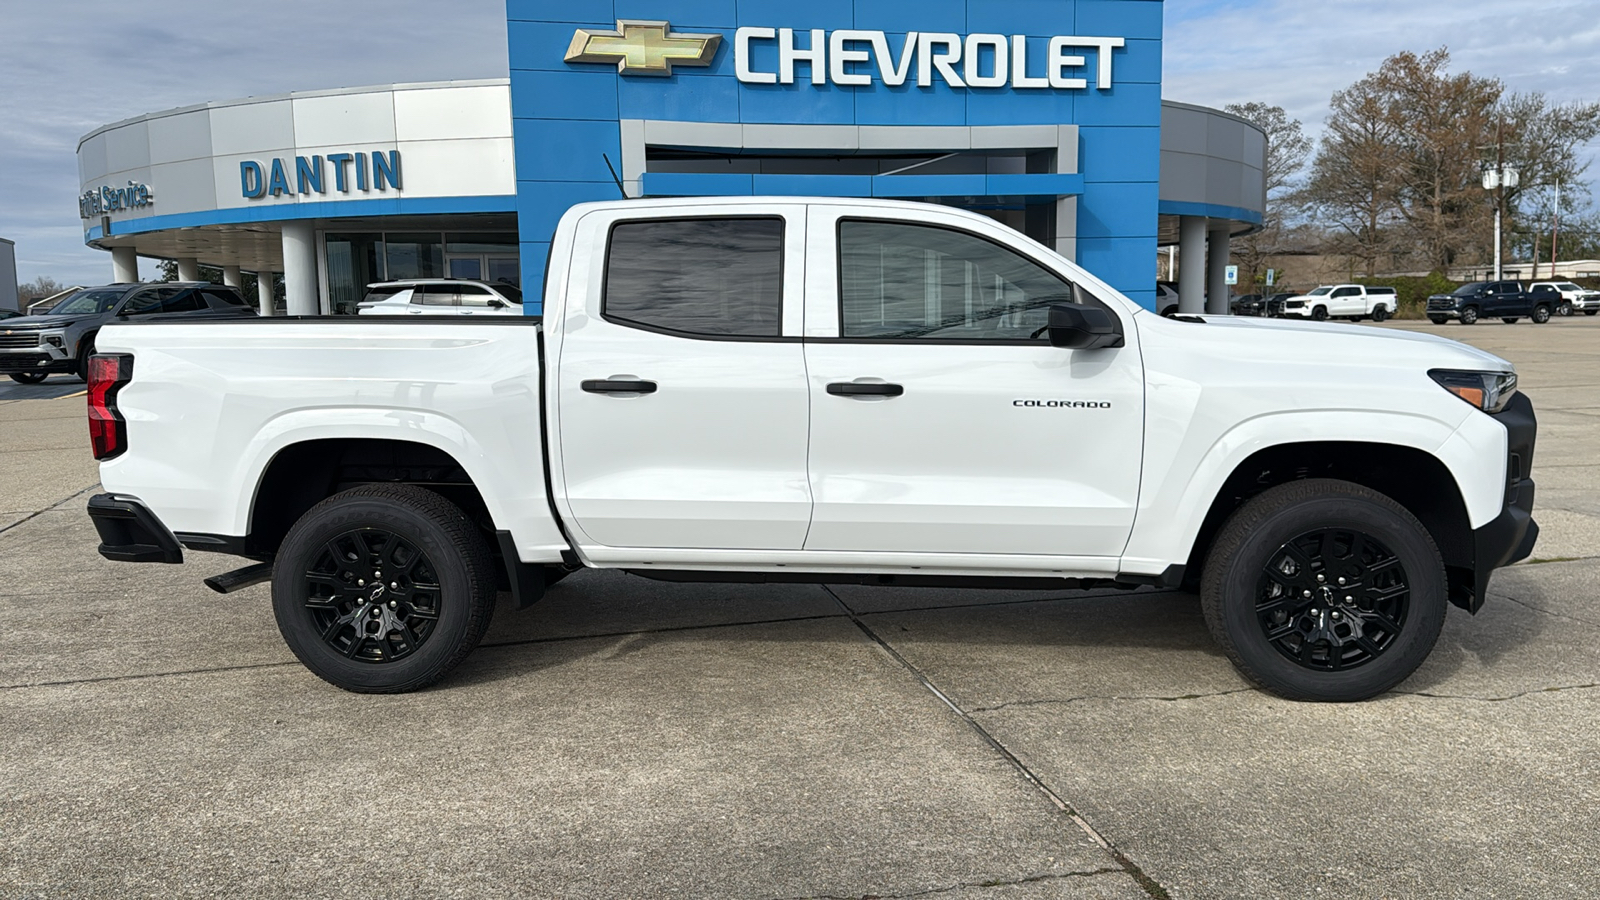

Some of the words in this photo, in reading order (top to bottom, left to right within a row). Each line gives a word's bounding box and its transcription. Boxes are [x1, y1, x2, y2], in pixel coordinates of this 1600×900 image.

[734, 26, 1126, 90] CHEVROLET
[239, 150, 402, 198] DANTIN
[102, 180, 151, 211] Service
[1012, 399, 1112, 409] COLORADO
